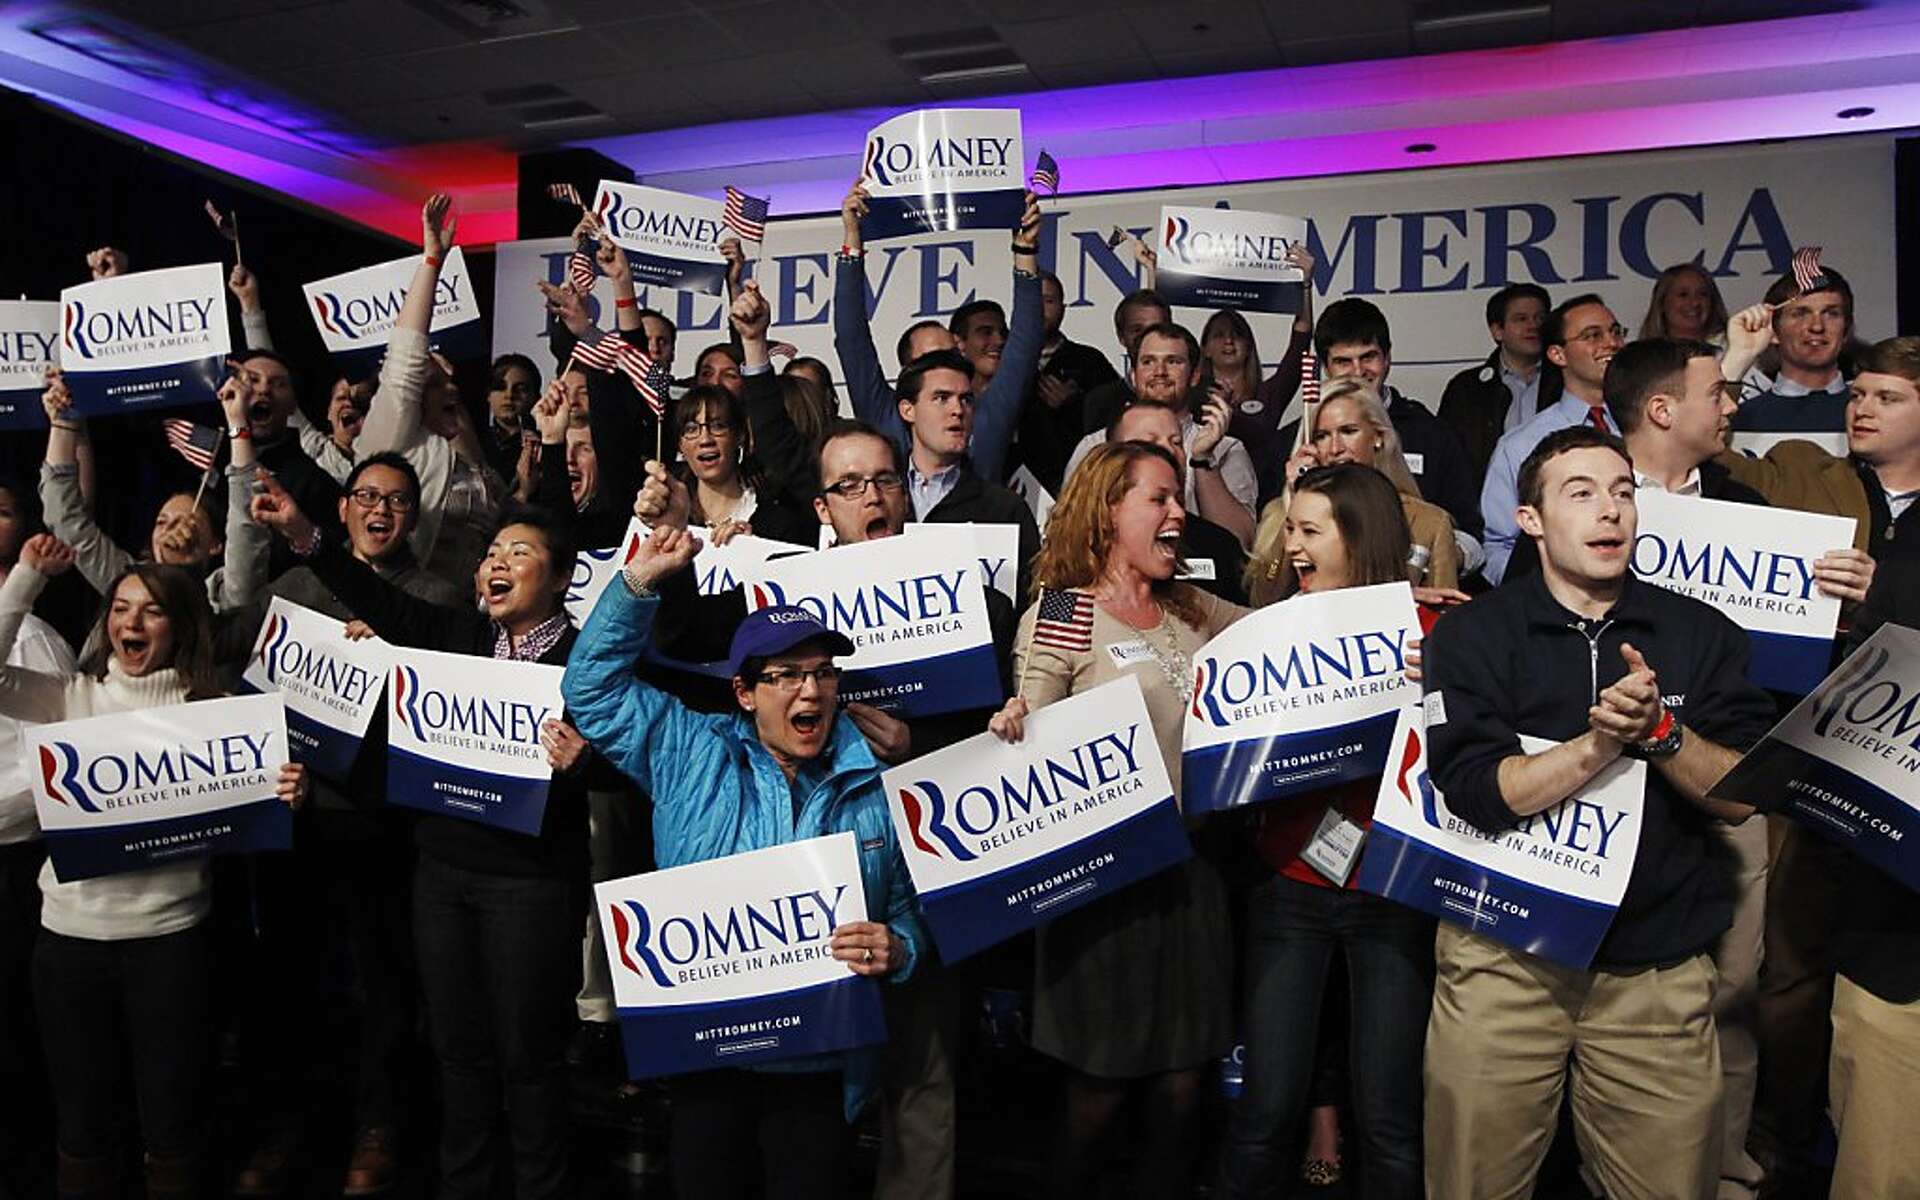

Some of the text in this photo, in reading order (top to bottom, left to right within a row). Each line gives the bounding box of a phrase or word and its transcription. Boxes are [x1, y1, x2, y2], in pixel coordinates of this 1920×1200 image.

[865, 137, 1013, 186] ROMNEY
[958, 168, 1007, 178] AMERICA
[598, 190, 727, 244] ROMNEY
[663, 238, 672, 247] IN
[1215, 187, 1797, 297] MERICA
[65, 298, 214, 359] ROMNEY
[314, 275, 459, 339] ROMEY
[97, 335, 210, 357] BELIEVE IN AMERICA
[1629, 533, 1816, 600] OMNEY
[1702, 589, 1720, 602] IN
[1726, 594, 1807, 616] AMERICA
[869, 632, 885, 645] IN
[891, 621, 963, 641] AMERICA
[260, 613, 378, 706] ROMNEY
[1192, 628, 1408, 727] ROMNEY
[310, 688, 320, 701] IN
[396, 664, 549, 744] ROMNEY
[1234, 676, 1407, 721] BELIEVE IN AMERICA
[430, 732, 539, 760] BELIEVE IN AMERICA
[1250, 743, 1363, 774] MITTROMNEY.COM
[1831, 723, 1920, 774] BELIEVE IN
[39, 731, 272, 813] ROMNEY
[106, 774, 267, 809] BELIEVE IN AMERICA
[433, 781, 502, 802] MITTROMNEY.COM
[900, 724, 1142, 861] ROMNEY
[980, 777, 1143, 852] BELIEVE IN AMERICA
[1786, 779, 1904, 842] MITTROMNEY.COM
[125, 824, 232, 851] MITTROMNEY.COM
[1506, 836, 1525, 851] IN
[1528, 845, 1601, 878] AMERICA
[1007, 853, 1115, 906] MITTROMNEY.COM
[1434, 876, 1529, 919] MITTROMNEY.COM
[611, 885, 848, 987] ROMNEY
[678, 944, 832, 984] BELIEVE IN AMERIC
[695, 1016, 801, 1041] MITTROMNEY.COM
